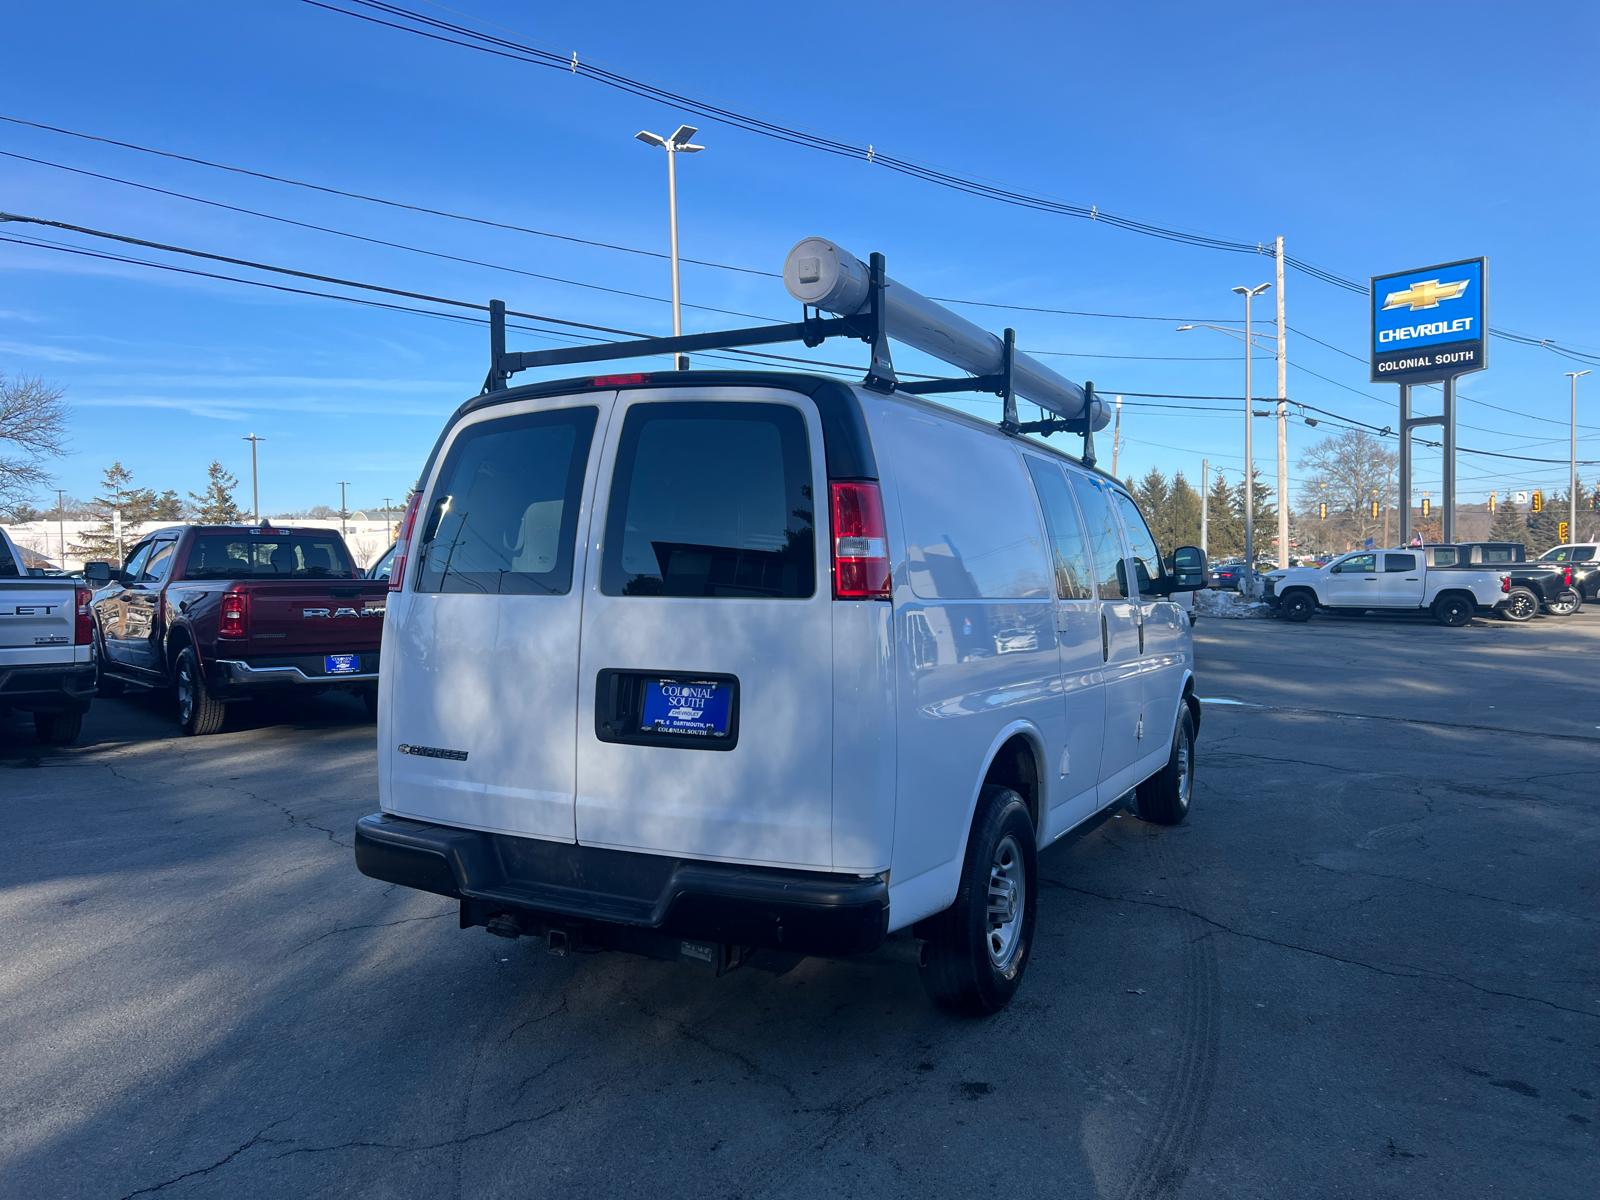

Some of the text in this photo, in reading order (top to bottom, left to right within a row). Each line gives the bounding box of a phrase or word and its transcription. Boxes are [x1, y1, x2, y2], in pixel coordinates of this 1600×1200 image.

[1379, 317, 1473, 343] CHEVROLET
[1378, 351, 1474, 372] COLONIAL SOUTH
[303, 607, 386, 618] RAM
[662, 686, 714, 699] COLONIAL
[668, 697, 705, 708] SOUTH
[410, 745, 469, 761] EXPRESS
